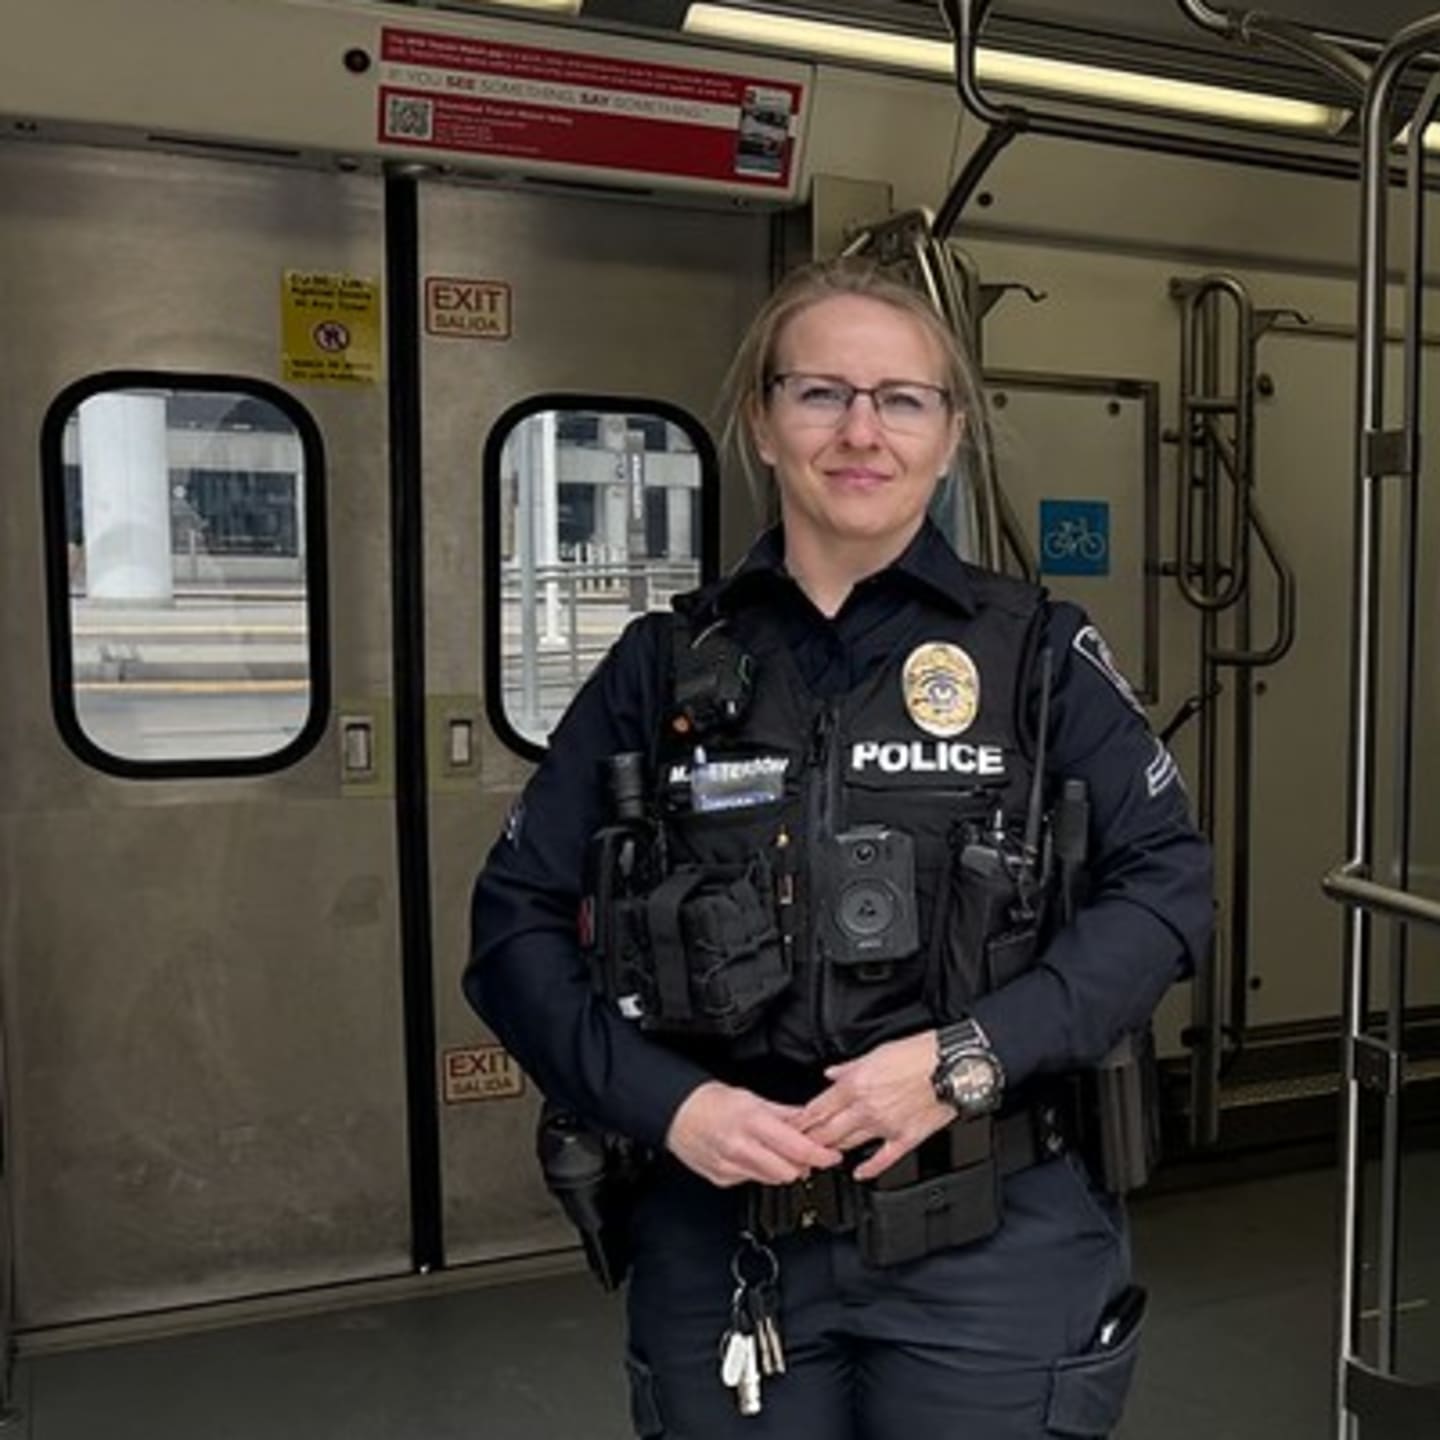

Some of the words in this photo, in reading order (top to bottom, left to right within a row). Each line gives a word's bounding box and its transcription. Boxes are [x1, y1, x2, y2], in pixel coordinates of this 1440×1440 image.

[408, 71, 441, 86] YOU
[446, 75, 475, 91] SEE
[580, 92, 610, 106] SAY
[434, 286, 502, 313] EXIT
[435, 313, 500, 332] SALIDA
[852, 740, 1005, 775] POLICE
[449, 1050, 510, 1078] EXIT
